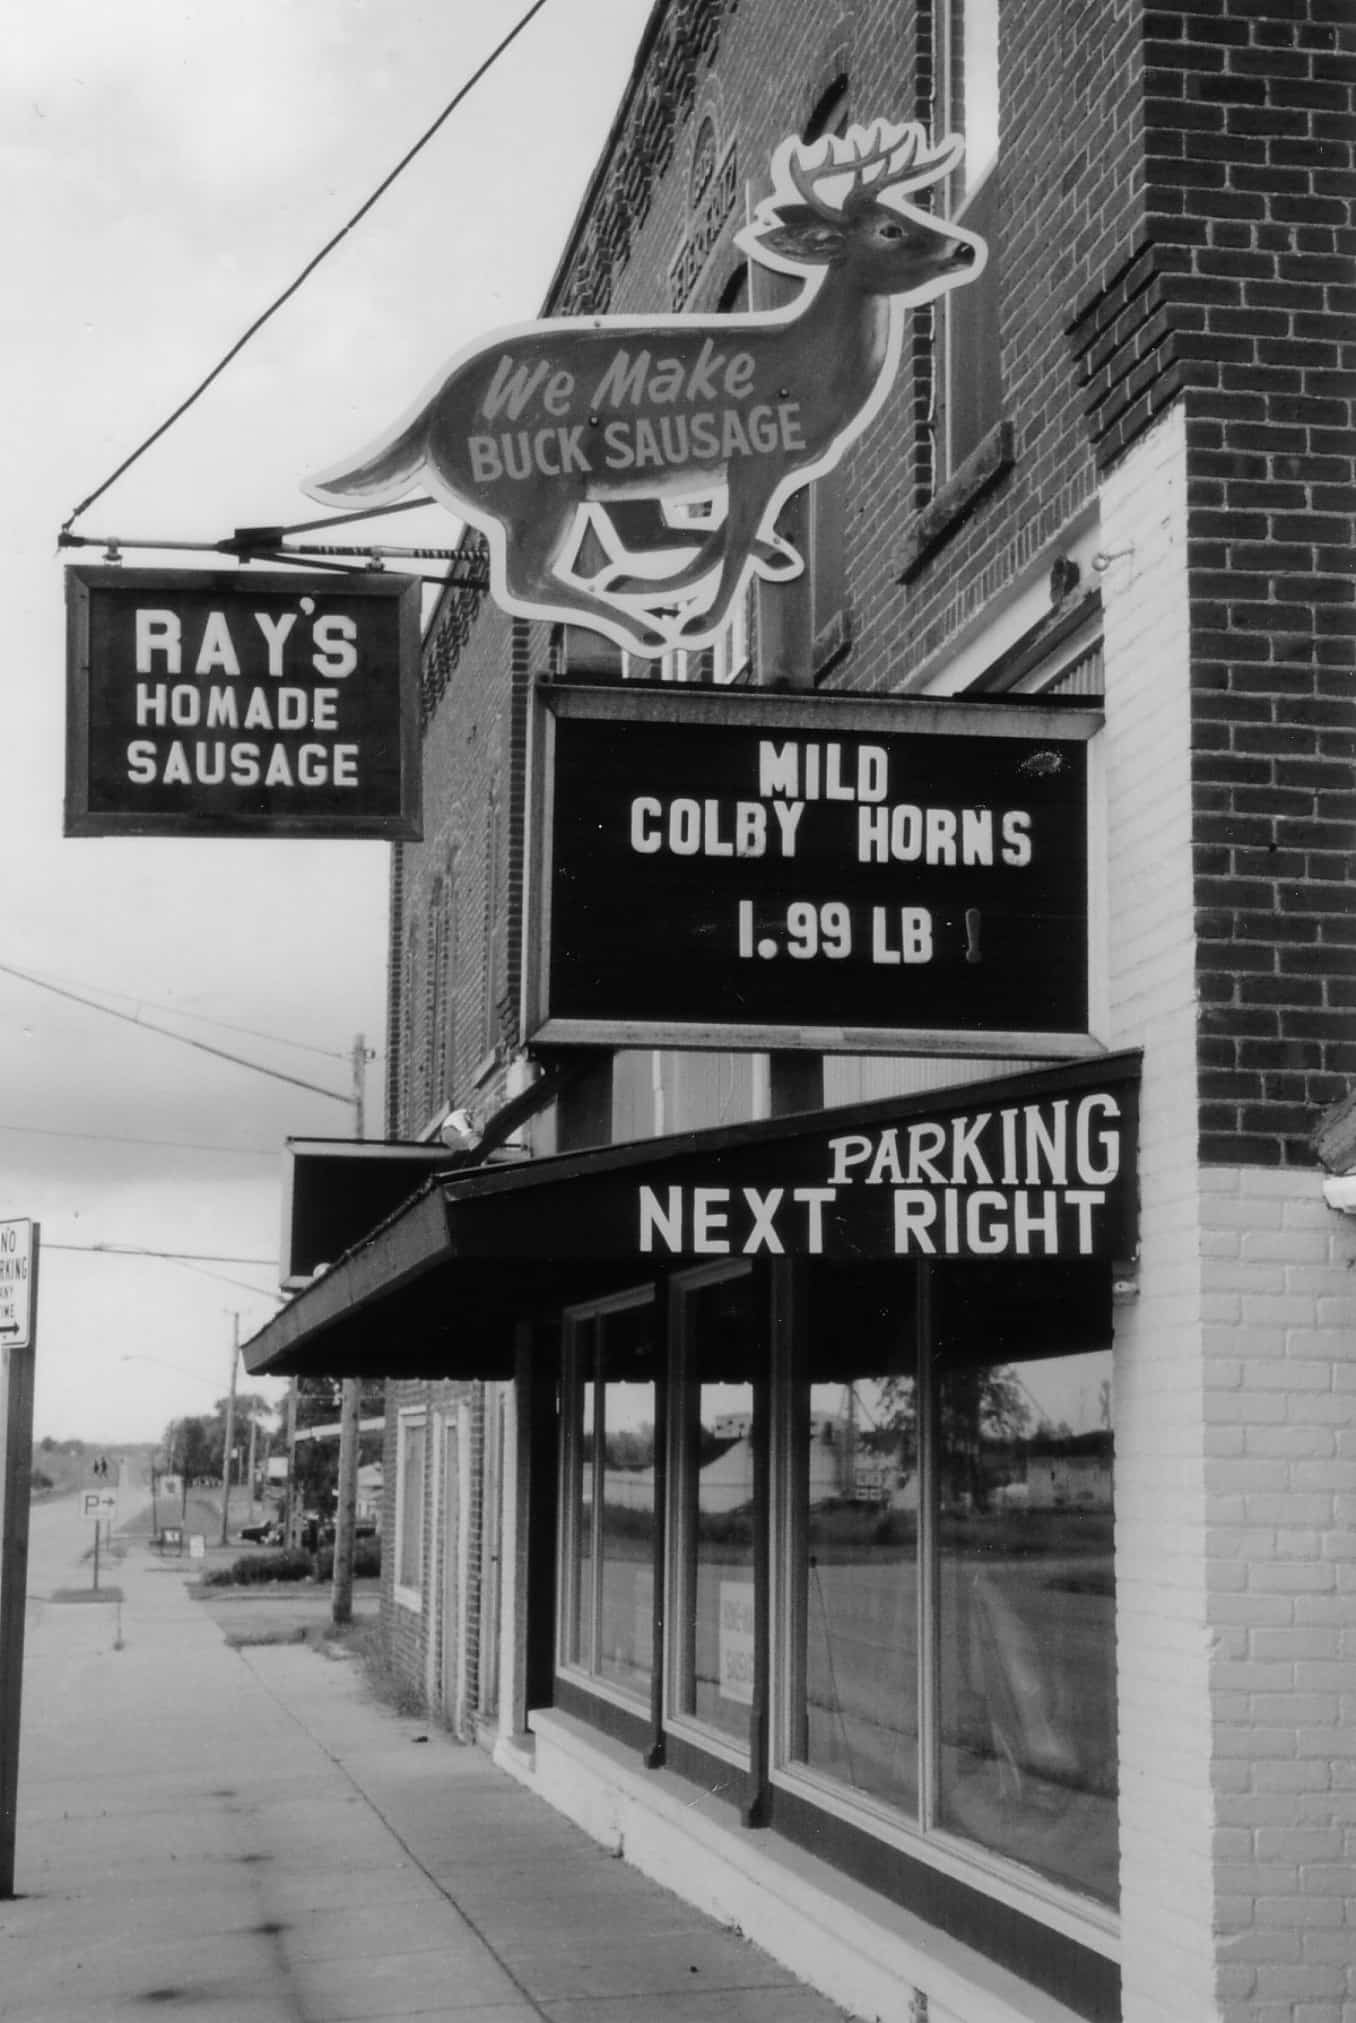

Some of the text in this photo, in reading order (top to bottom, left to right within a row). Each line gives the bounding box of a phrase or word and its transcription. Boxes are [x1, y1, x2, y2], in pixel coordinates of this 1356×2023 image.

[482, 337, 756, 421] We Make
[467, 402, 806, 483] BUCK SAUSAGE
[135, 596, 358, 678] RAY'S
[136, 683, 339, 730] HOMADE
[127, 740, 359, 786] SAUSAGE
[759, 740, 889, 802] MILD
[630, 797, 1033, 867] COLBY HORNS
[738, 900, 852, 960] 1.99
[872, 905, 934, 964] LB
[827, 1093, 1121, 1186] PARKING
[1, 1230, 16, 1253] NO
[639, 1185, 1106, 1255] NEXT RIGHT
